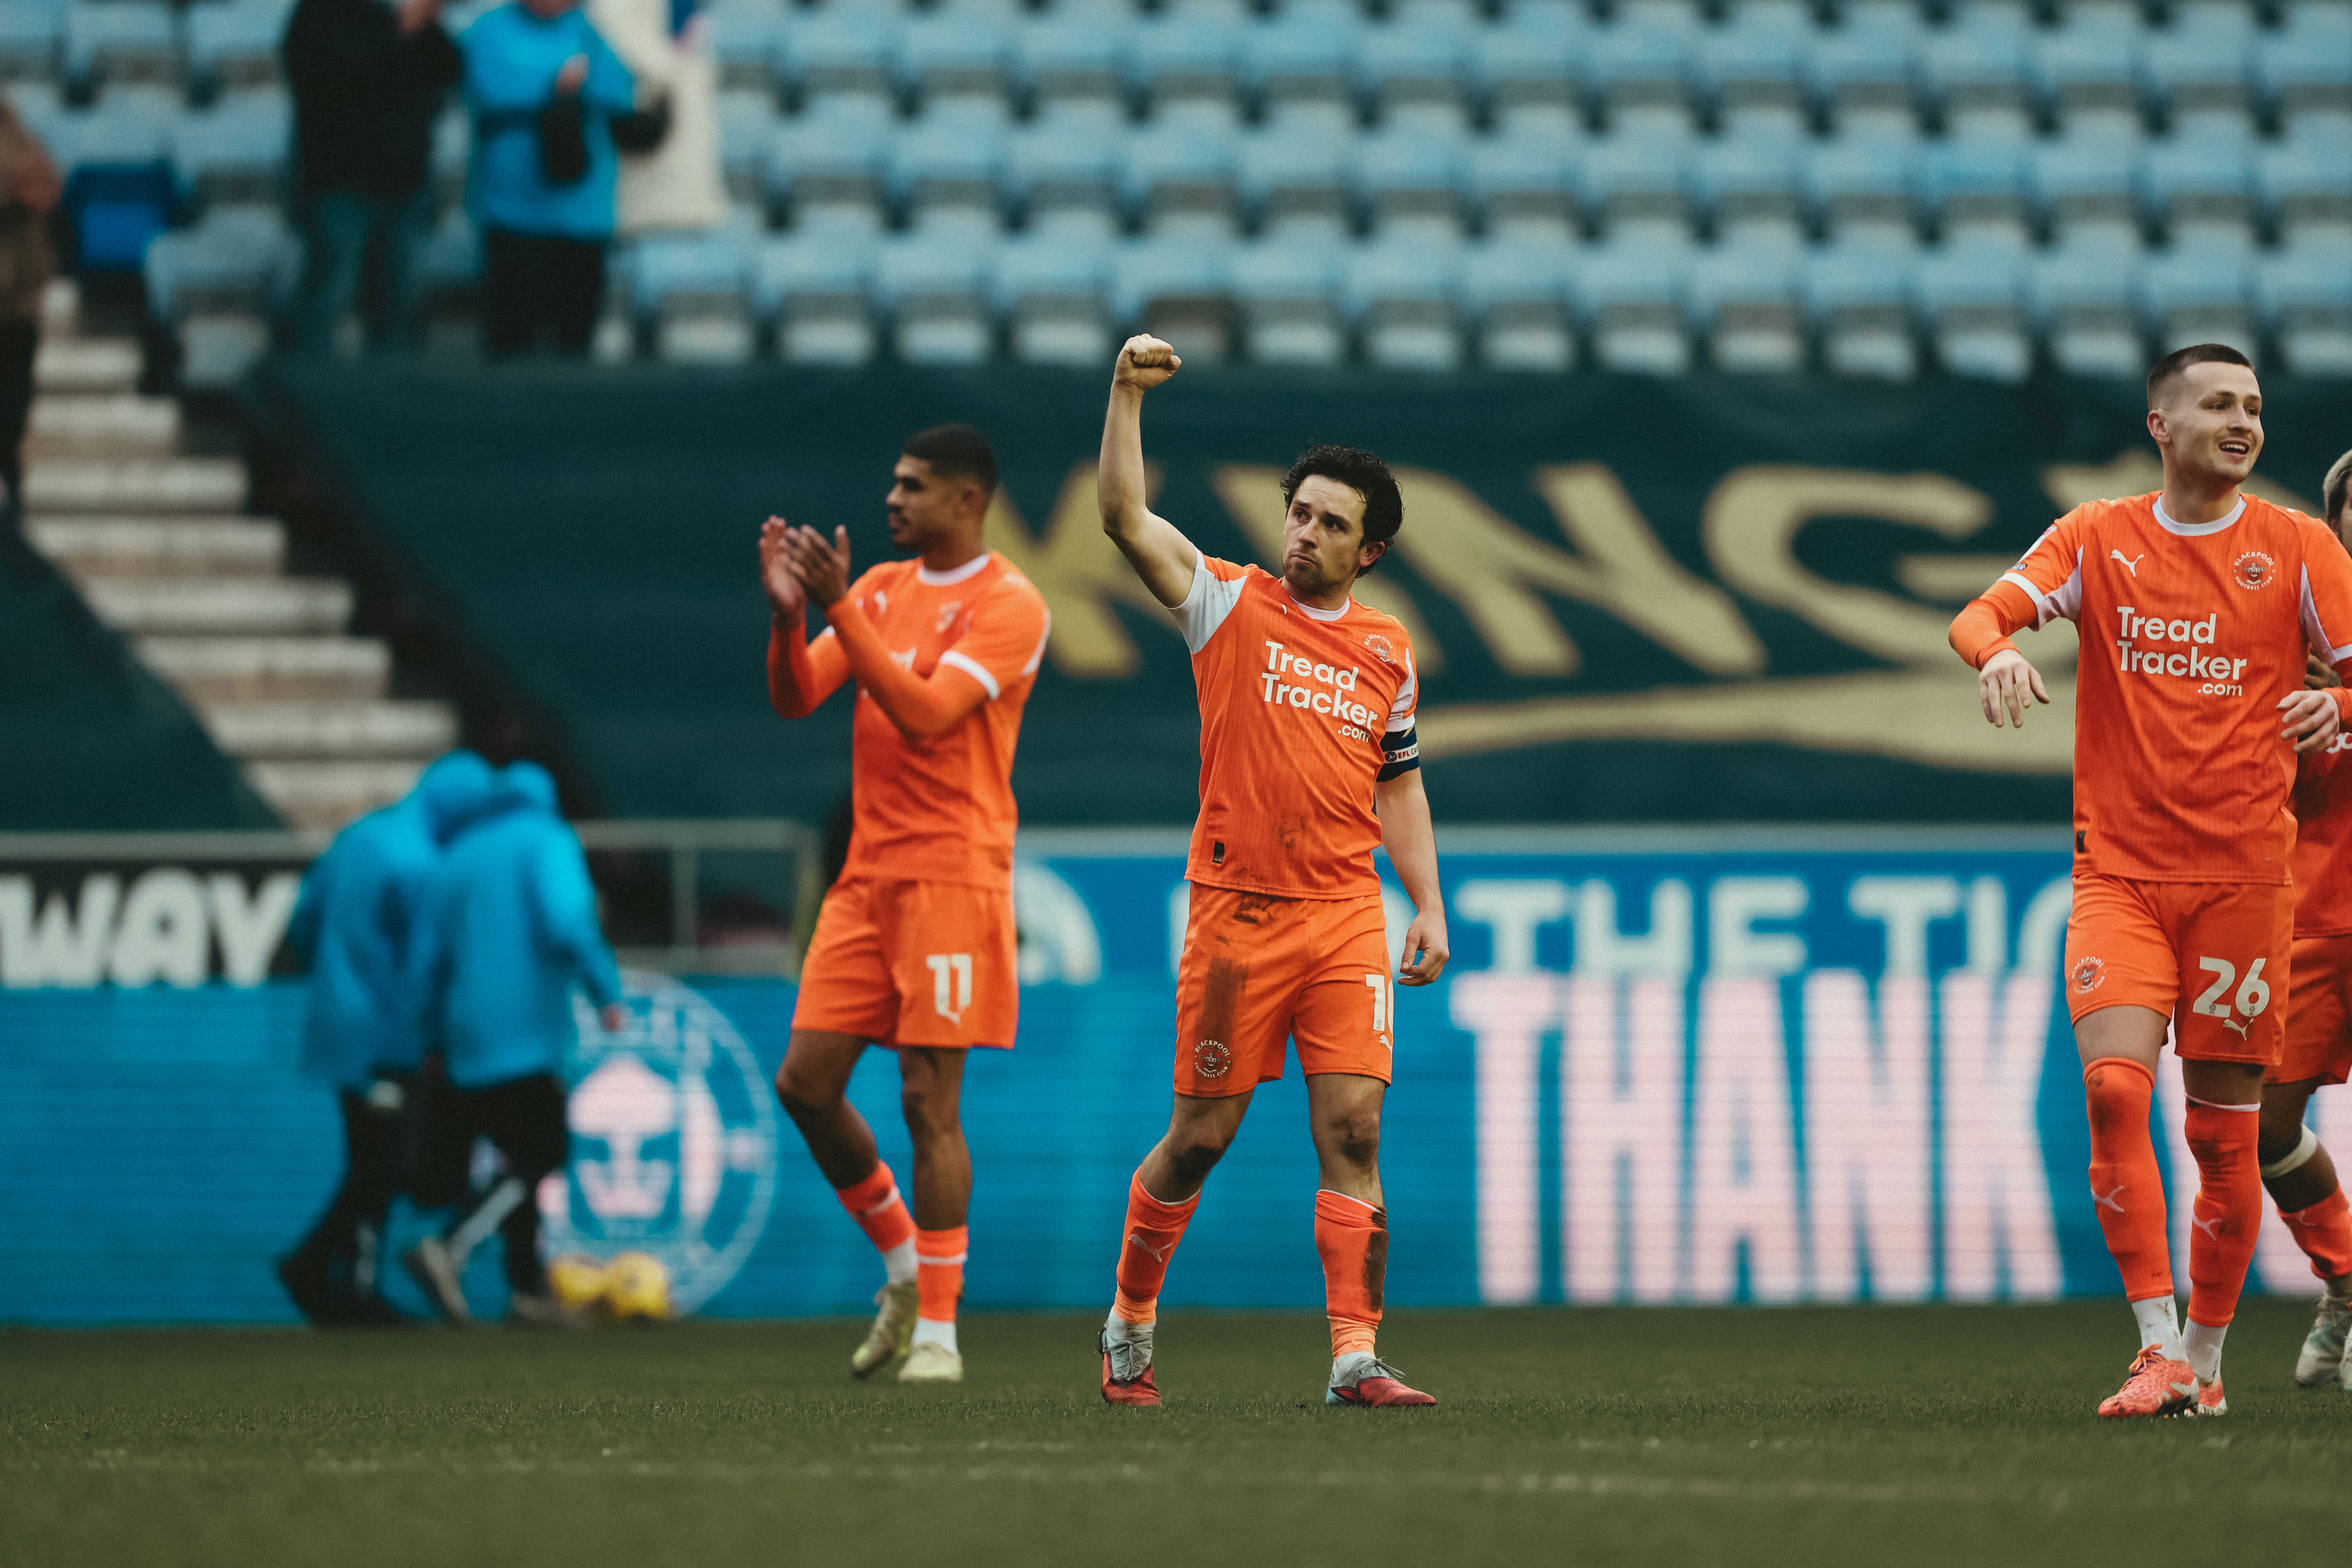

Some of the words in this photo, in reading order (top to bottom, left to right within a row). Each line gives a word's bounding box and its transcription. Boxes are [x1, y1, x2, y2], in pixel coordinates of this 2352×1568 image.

[2233, 551, 2274, 567] BLACKPOOL
[2117, 606, 2217, 644] Tread
[1265, 640, 1359, 692] Tread
[2117, 640, 2247, 680] Tracker
[1262, 672, 1378, 730] Tracker
[2197, 682, 2243, 697] .com
[1338, 725, 1372, 743] .com
[1398, 750, 1410, 759] EFL
[927, 953, 972, 1007] 11
[2193, 956, 2270, 1018] 26
[1194, 1040, 1230, 1057] BLACKPOOL
[1194, 1062, 1215, 1078] FOOTBALL
[1217, 1066, 1228, 1076] CLUB
[1449, 970, 2065, 1303] THANK
